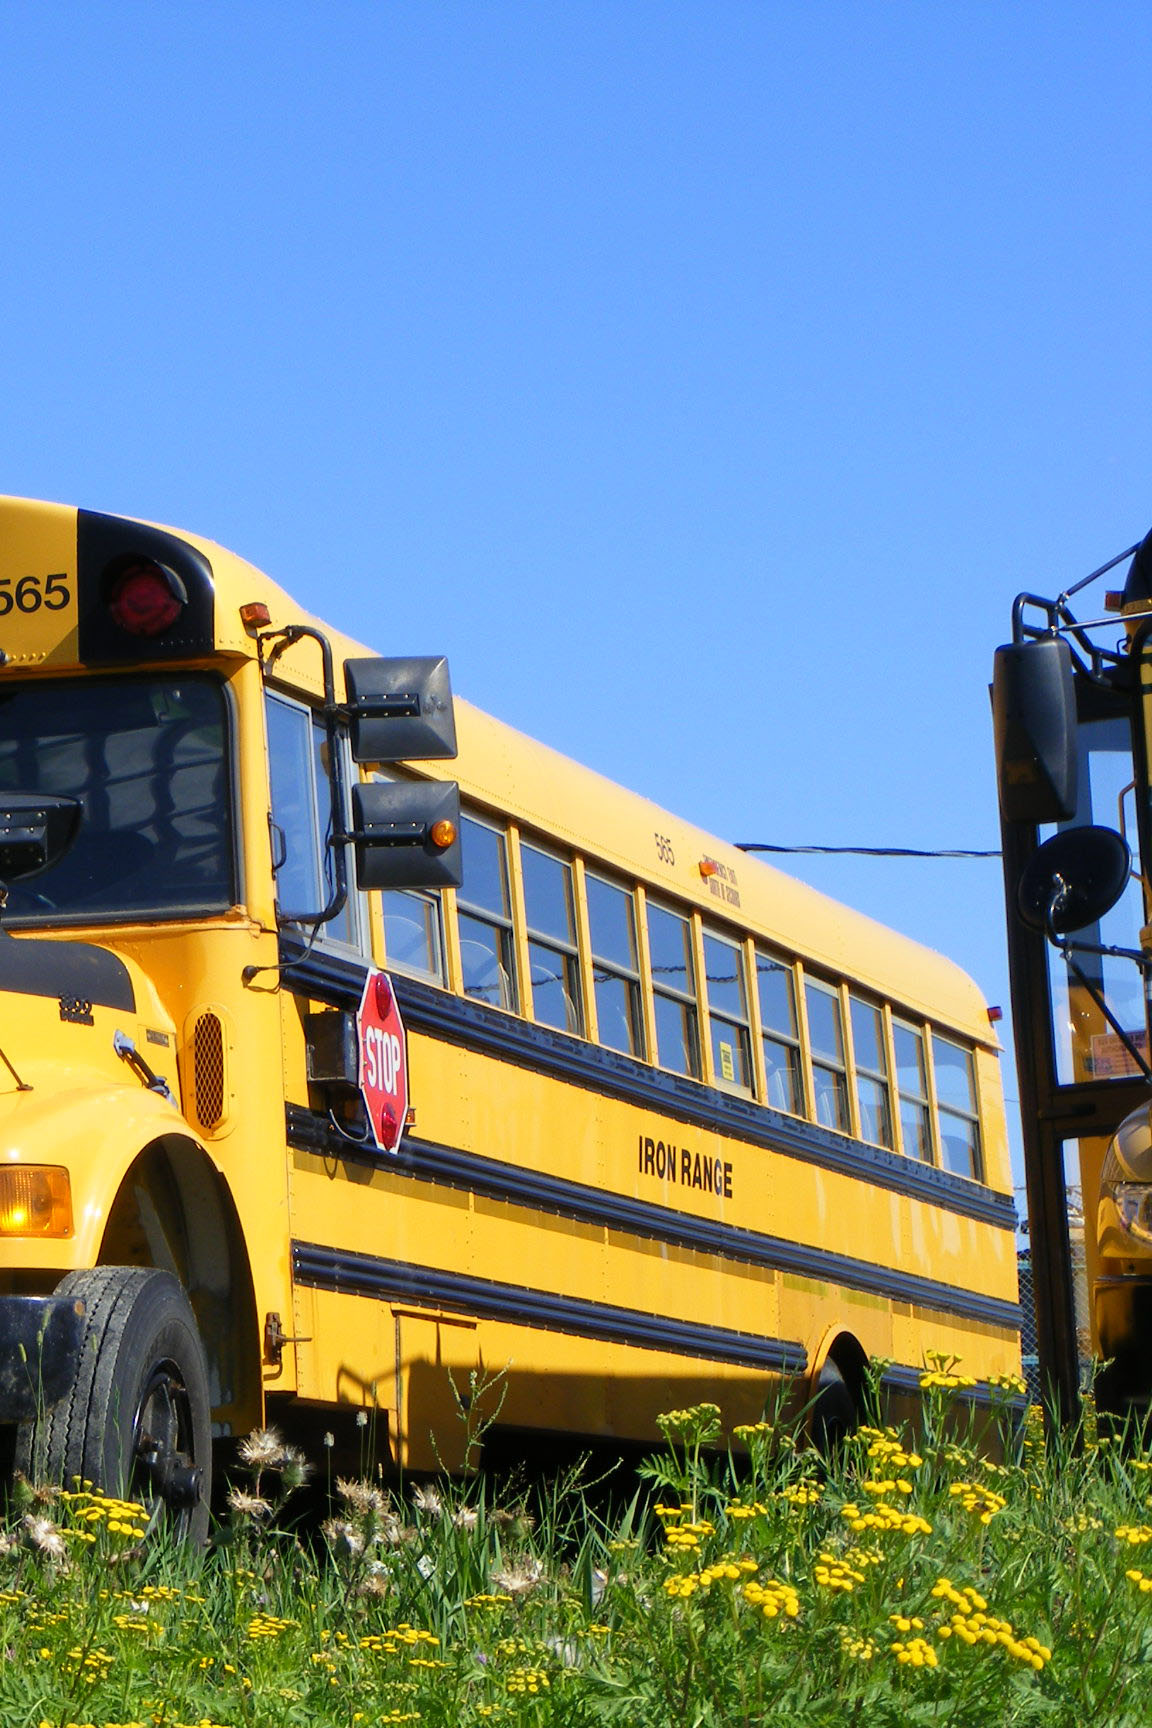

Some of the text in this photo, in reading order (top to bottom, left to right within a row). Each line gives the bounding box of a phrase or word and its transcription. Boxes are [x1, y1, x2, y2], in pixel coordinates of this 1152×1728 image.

[654, 832, 675, 867] 565
[364, 1025, 401, 1096] STOP
[639, 1135, 733, 1199] IRON RANGE
